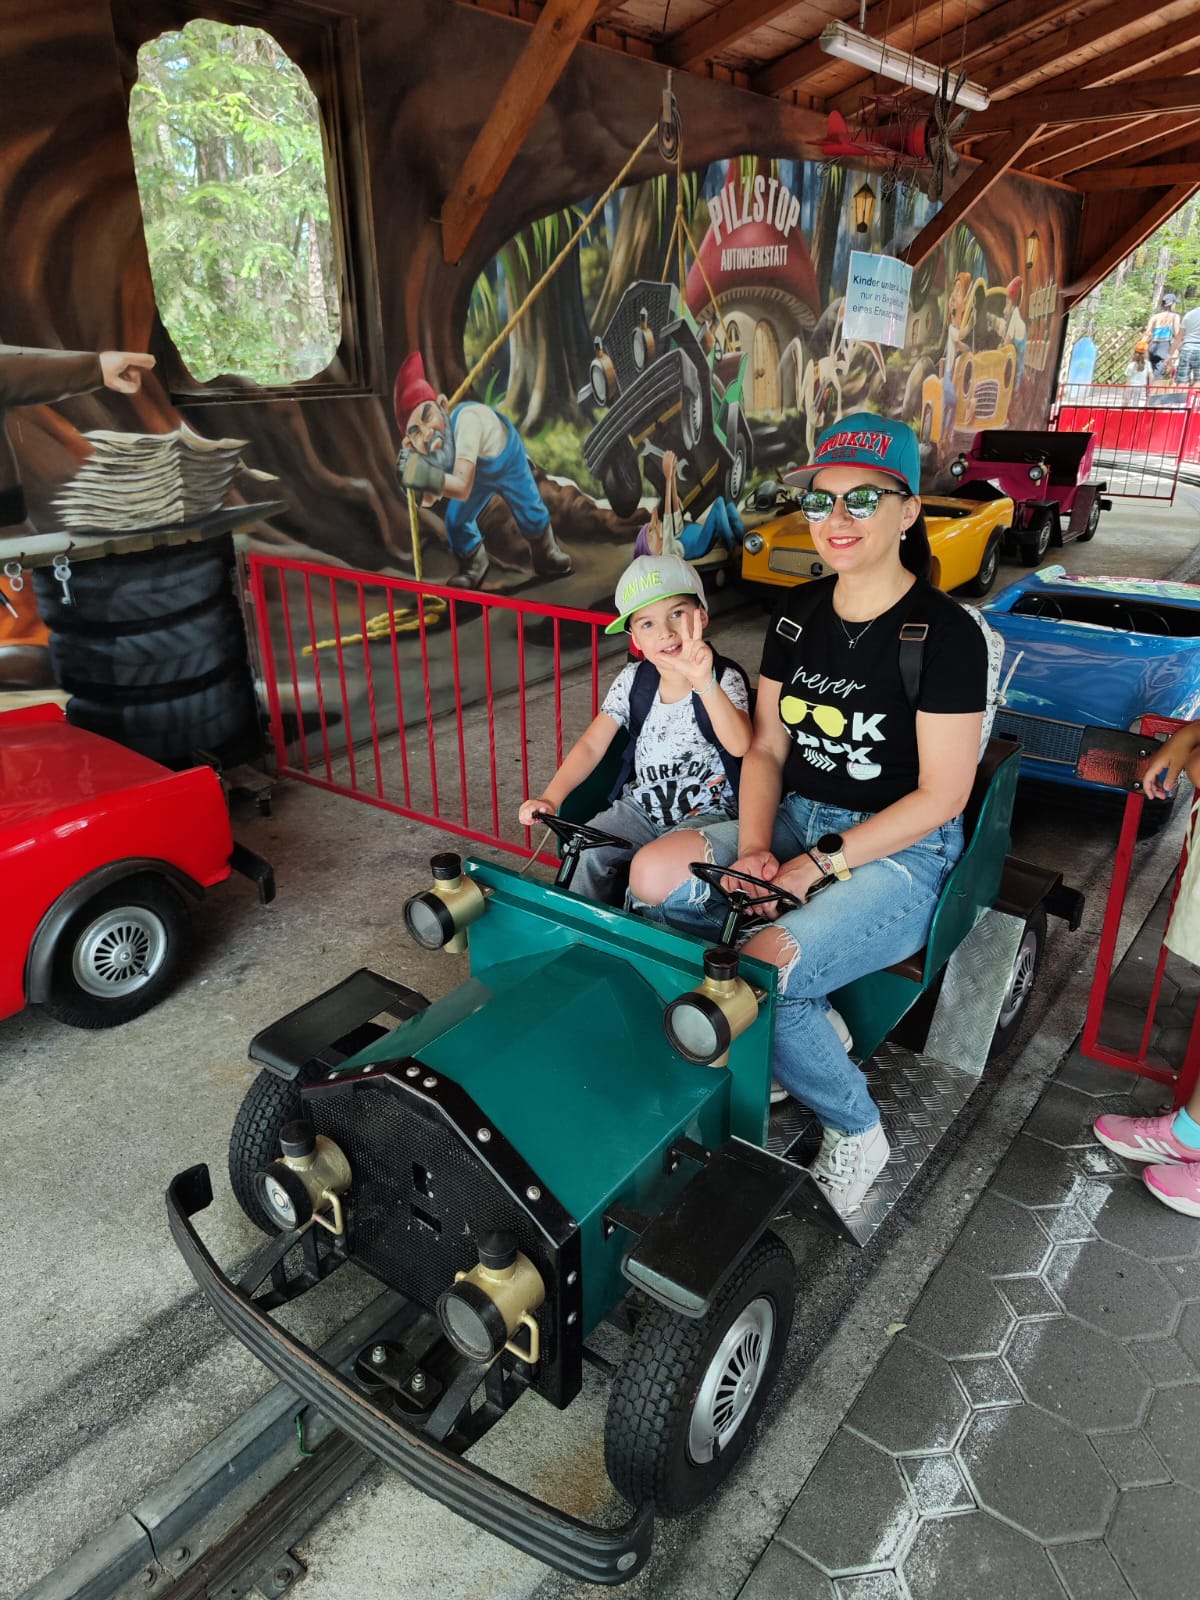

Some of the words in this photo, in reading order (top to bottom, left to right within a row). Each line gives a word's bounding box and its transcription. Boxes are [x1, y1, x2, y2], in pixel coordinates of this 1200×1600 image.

[708, 175, 801, 246] PILZSTOP
[720, 245, 788, 272] AUTOWERKSTATT
[853, 275, 880, 287] Kinder
[860, 292, 873, 300] nur
[875, 294, 881, 302] in
[852, 304, 873, 314] eines
[791, 666, 866, 699] never
